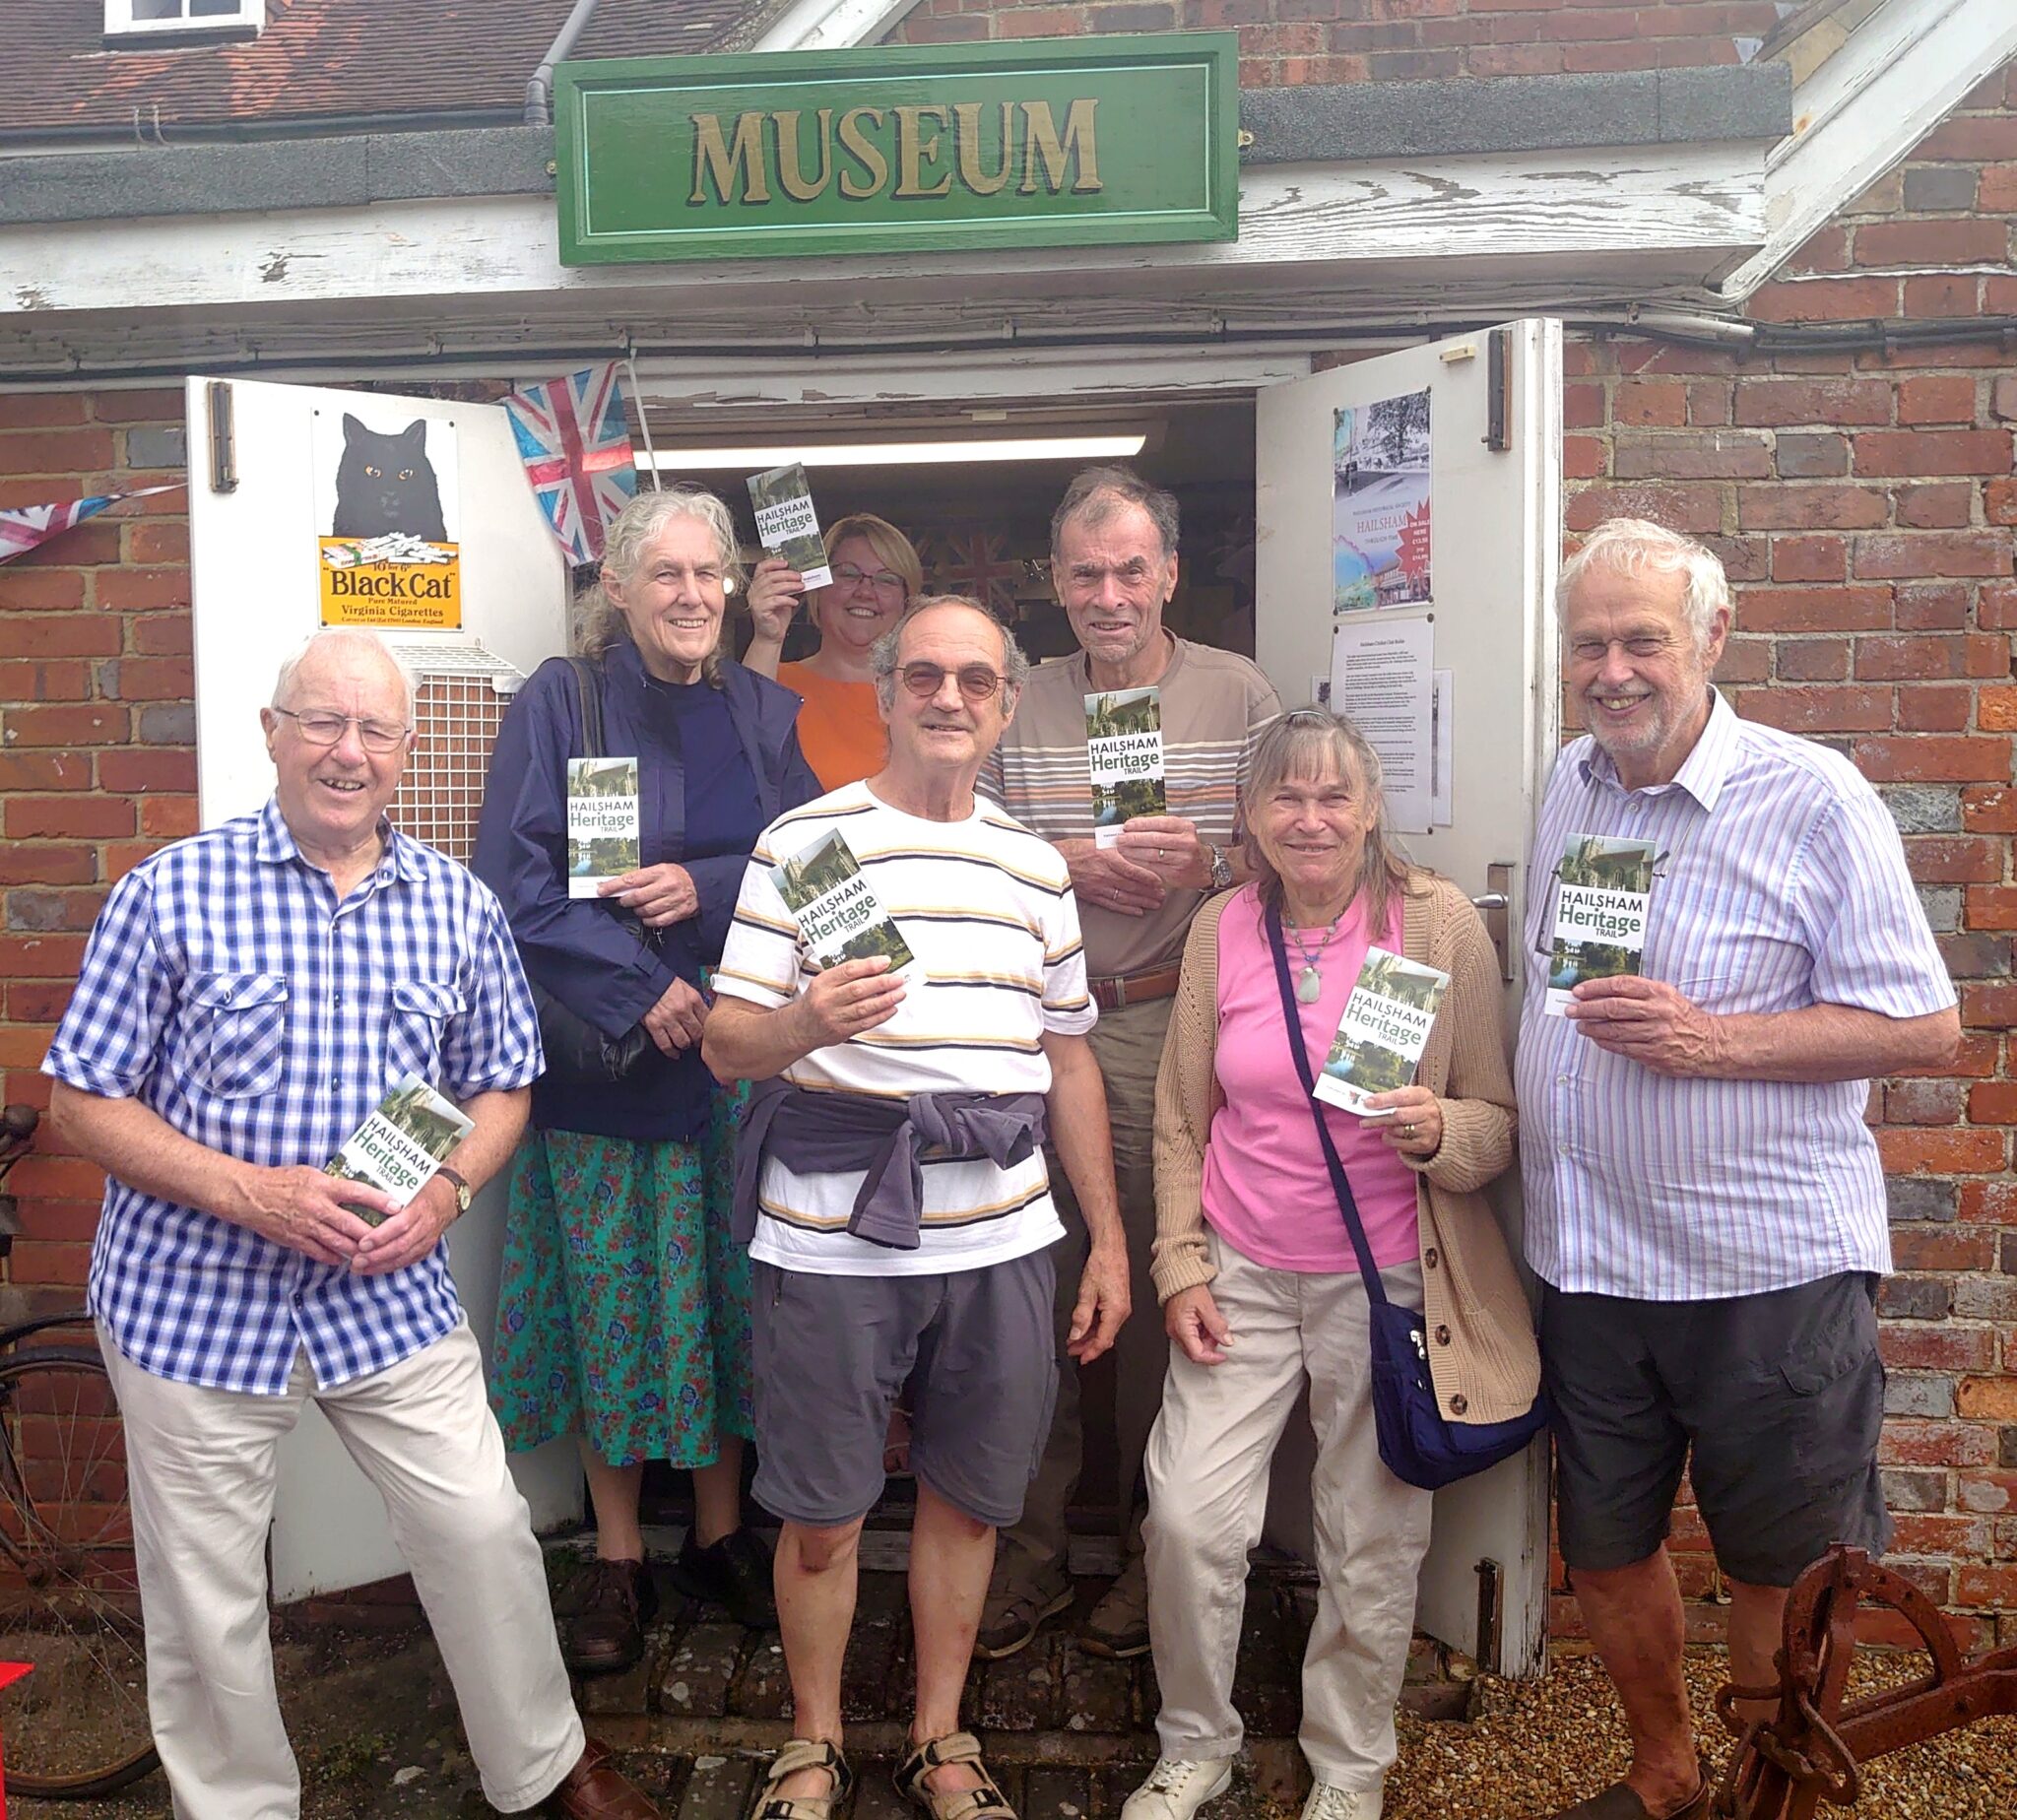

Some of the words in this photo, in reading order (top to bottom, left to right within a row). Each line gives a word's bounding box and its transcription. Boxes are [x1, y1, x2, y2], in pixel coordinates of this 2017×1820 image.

[686, 98, 1103, 207] MUSEUM
[756, 500, 810, 524] HAILSHAM
[759, 513, 813, 537] Heritage
[1357, 514, 1406, 533] HAILSHAM
[342, 605, 386, 617] Virginia
[389, 606, 443, 618] Cigarettes
[1090, 737, 1158, 754] HAILSHAM
[1091, 752, 1159, 772] Heritage
[570, 801, 634, 812] HAILSHAM
[570, 812, 634, 830] Heritage
[798, 879, 867, 928] HAILSHAM
[1561, 890, 1643, 912] HAILSHAM
[805, 895, 878, 945] Heritage
[844, 919, 866, 933] TRAIL
[1559, 903, 1641, 937] Heritage
[1595, 929, 1617, 939] TRAIL
[1352, 993, 1427, 1028] HAILSHAM
[1346, 1003, 1422, 1046] Heritage
[1378, 1032, 1399, 1046] TRAIL
[366, 1118, 431, 1176] HAILSHAM
[354, 1127, 419, 1190] Heritage
[376, 1165, 394, 1184] TRAIL
